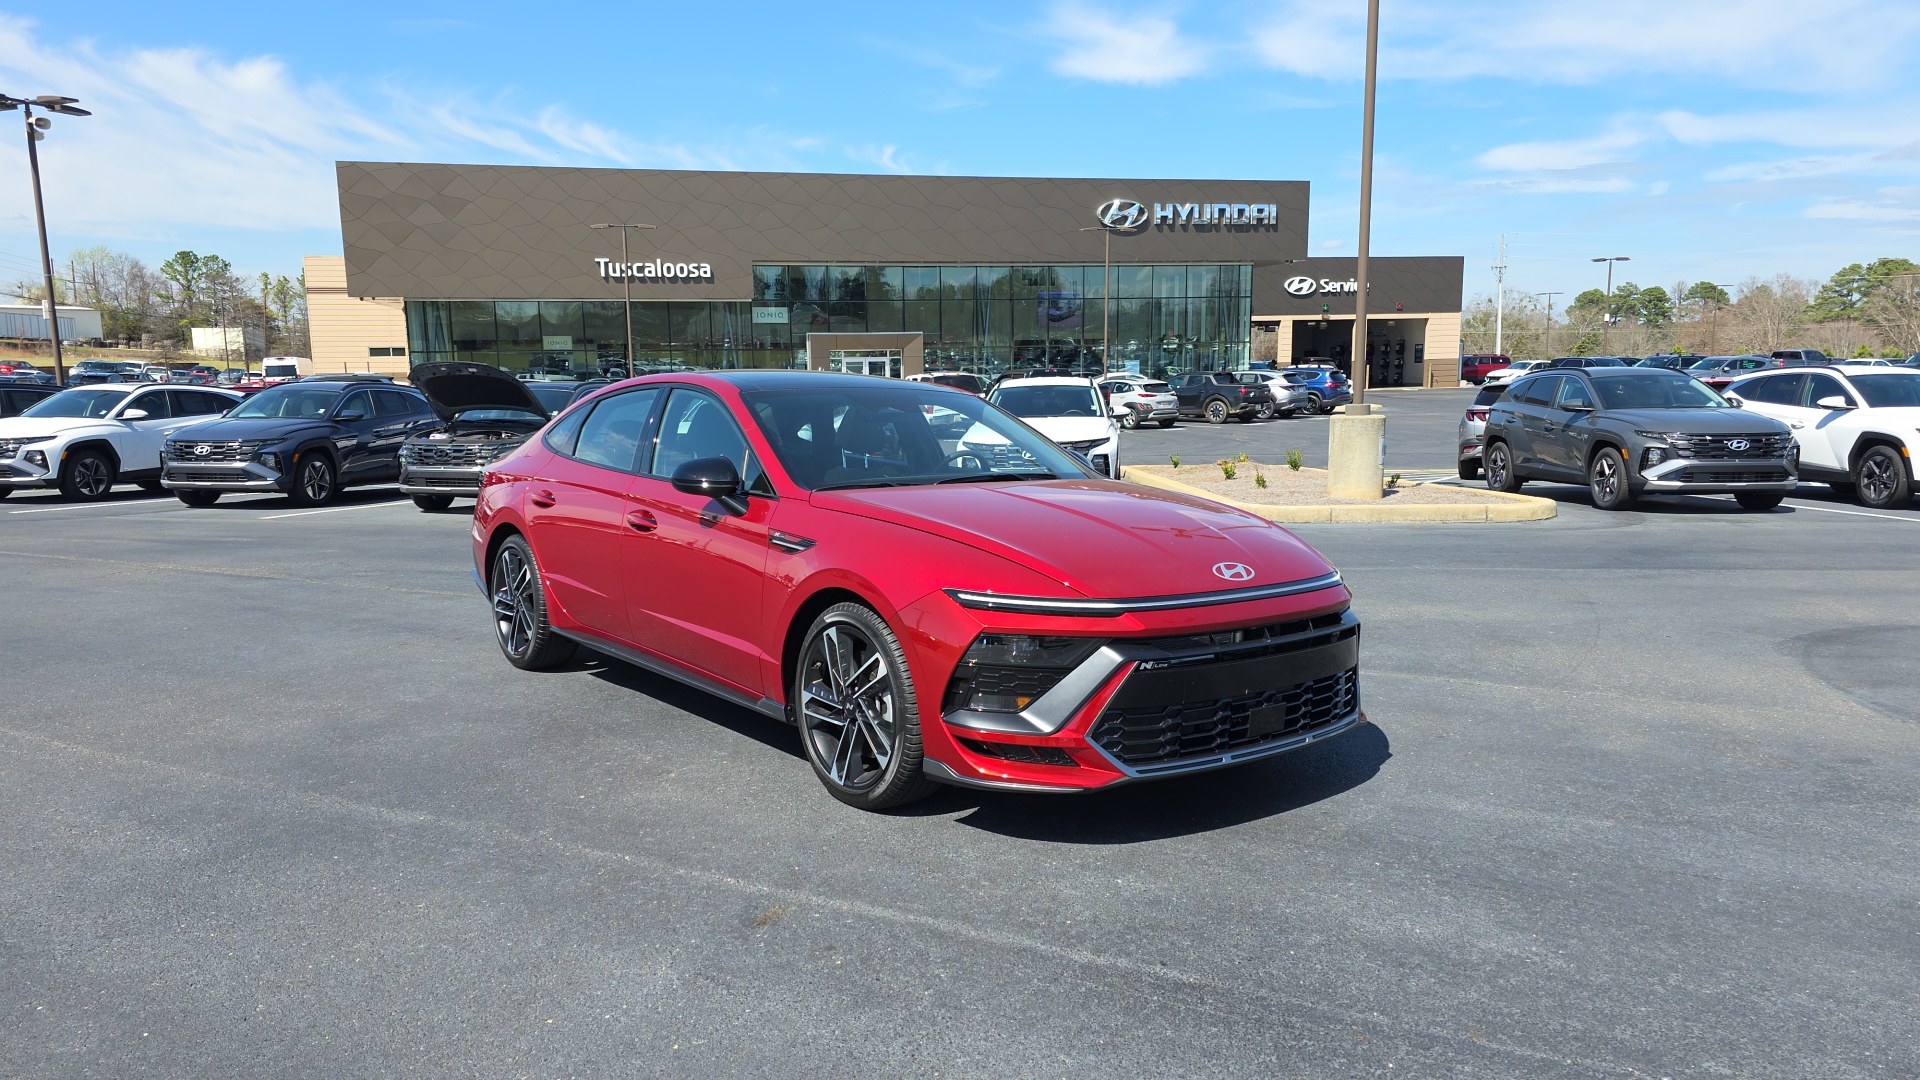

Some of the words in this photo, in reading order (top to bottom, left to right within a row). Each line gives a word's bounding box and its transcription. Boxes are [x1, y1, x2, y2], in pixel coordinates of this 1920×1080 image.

[1153, 203, 1277, 225] HYUNDAI
[594, 257, 712, 278] Tuscaloosa
[1319, 278, 1370, 293] Servi
[756, 311, 784, 319] IONIQ
